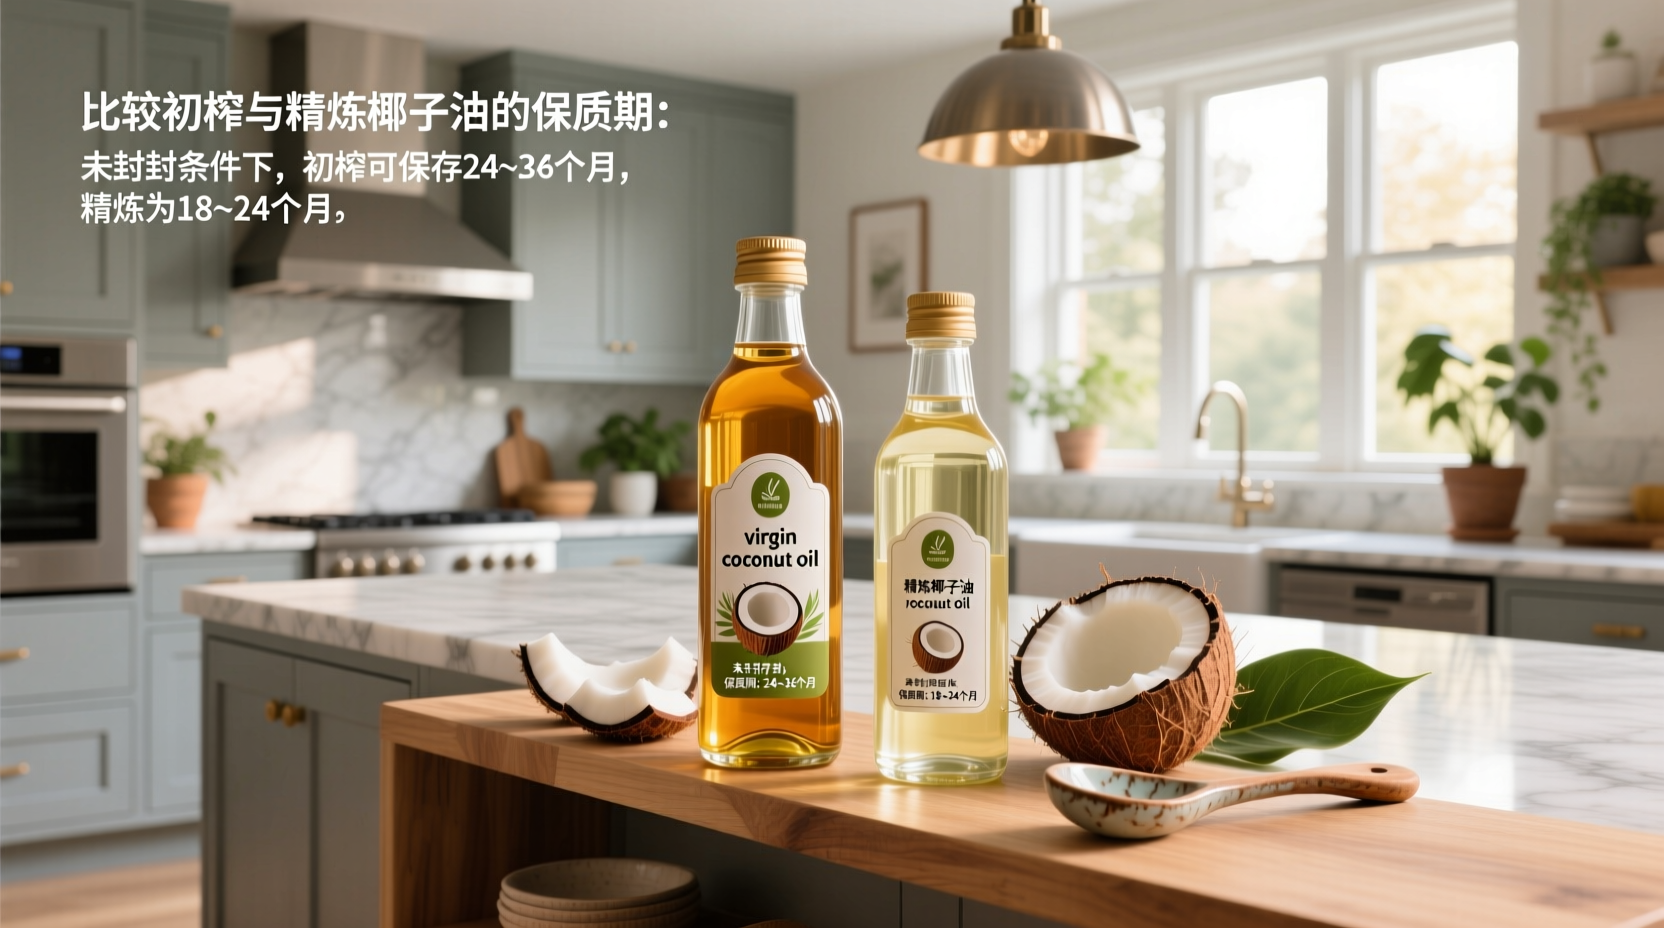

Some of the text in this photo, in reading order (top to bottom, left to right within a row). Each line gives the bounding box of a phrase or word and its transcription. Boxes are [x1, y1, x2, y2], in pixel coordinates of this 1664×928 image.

[744, 527, 797, 550] virgin
[722, 549, 819, 568] coconut oil
[954, 596, 970, 609] oil
